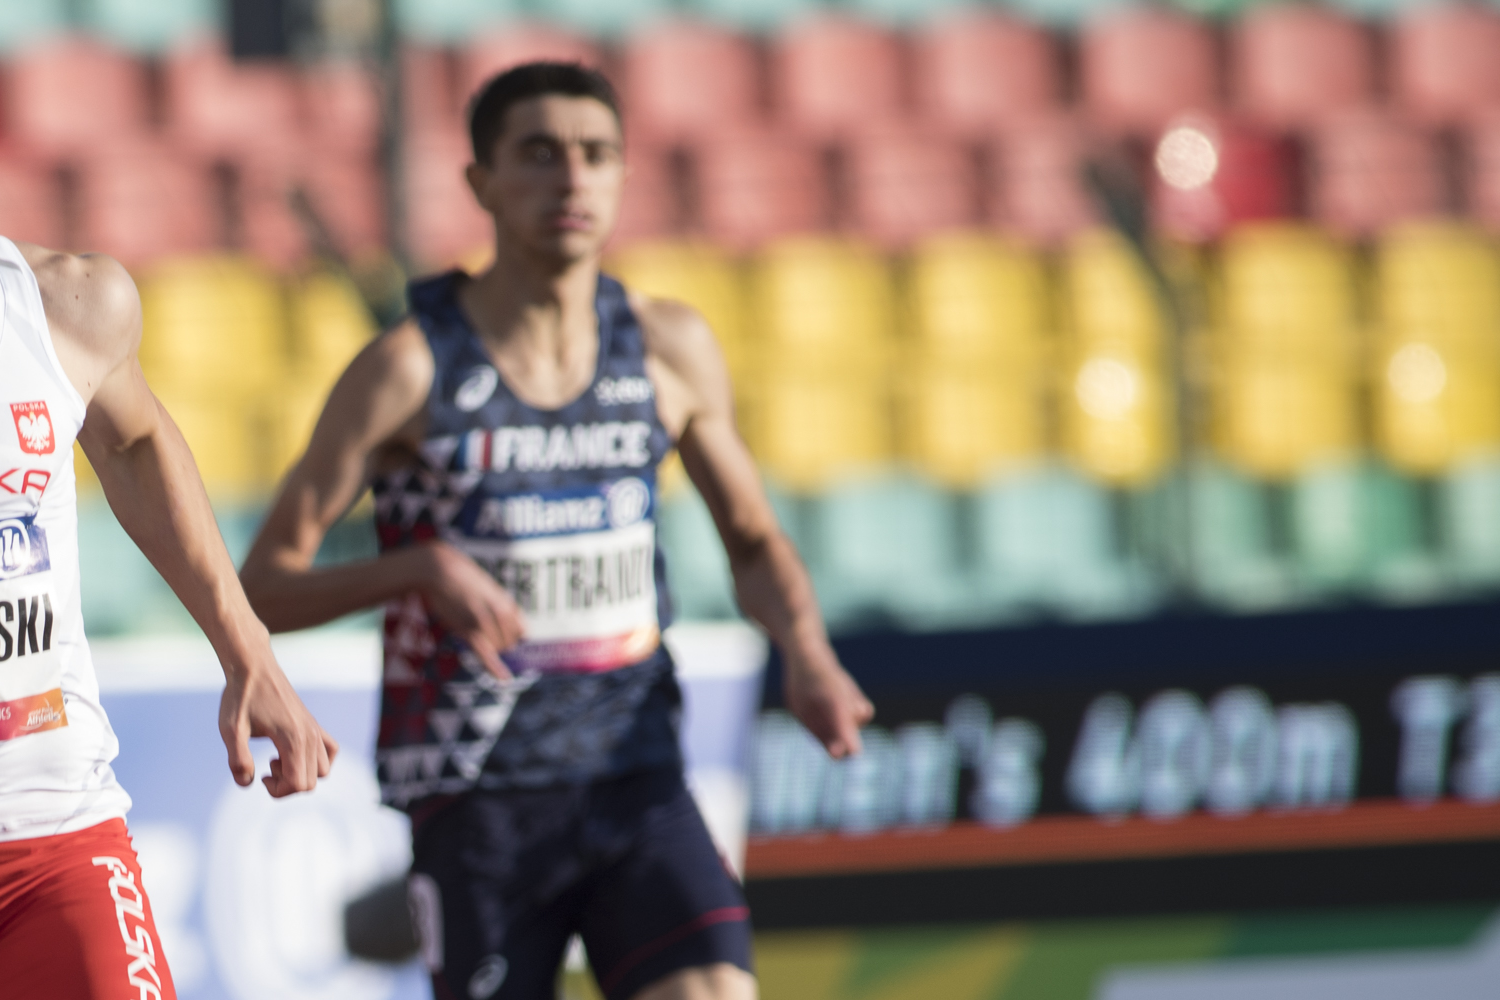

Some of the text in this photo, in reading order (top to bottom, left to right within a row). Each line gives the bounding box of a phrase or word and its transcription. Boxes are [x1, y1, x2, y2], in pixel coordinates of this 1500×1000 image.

[13, 401, 46, 412] POLSKA
[491, 420, 651, 474] FRANCE
[1066, 687, 1360, 824] 400m
